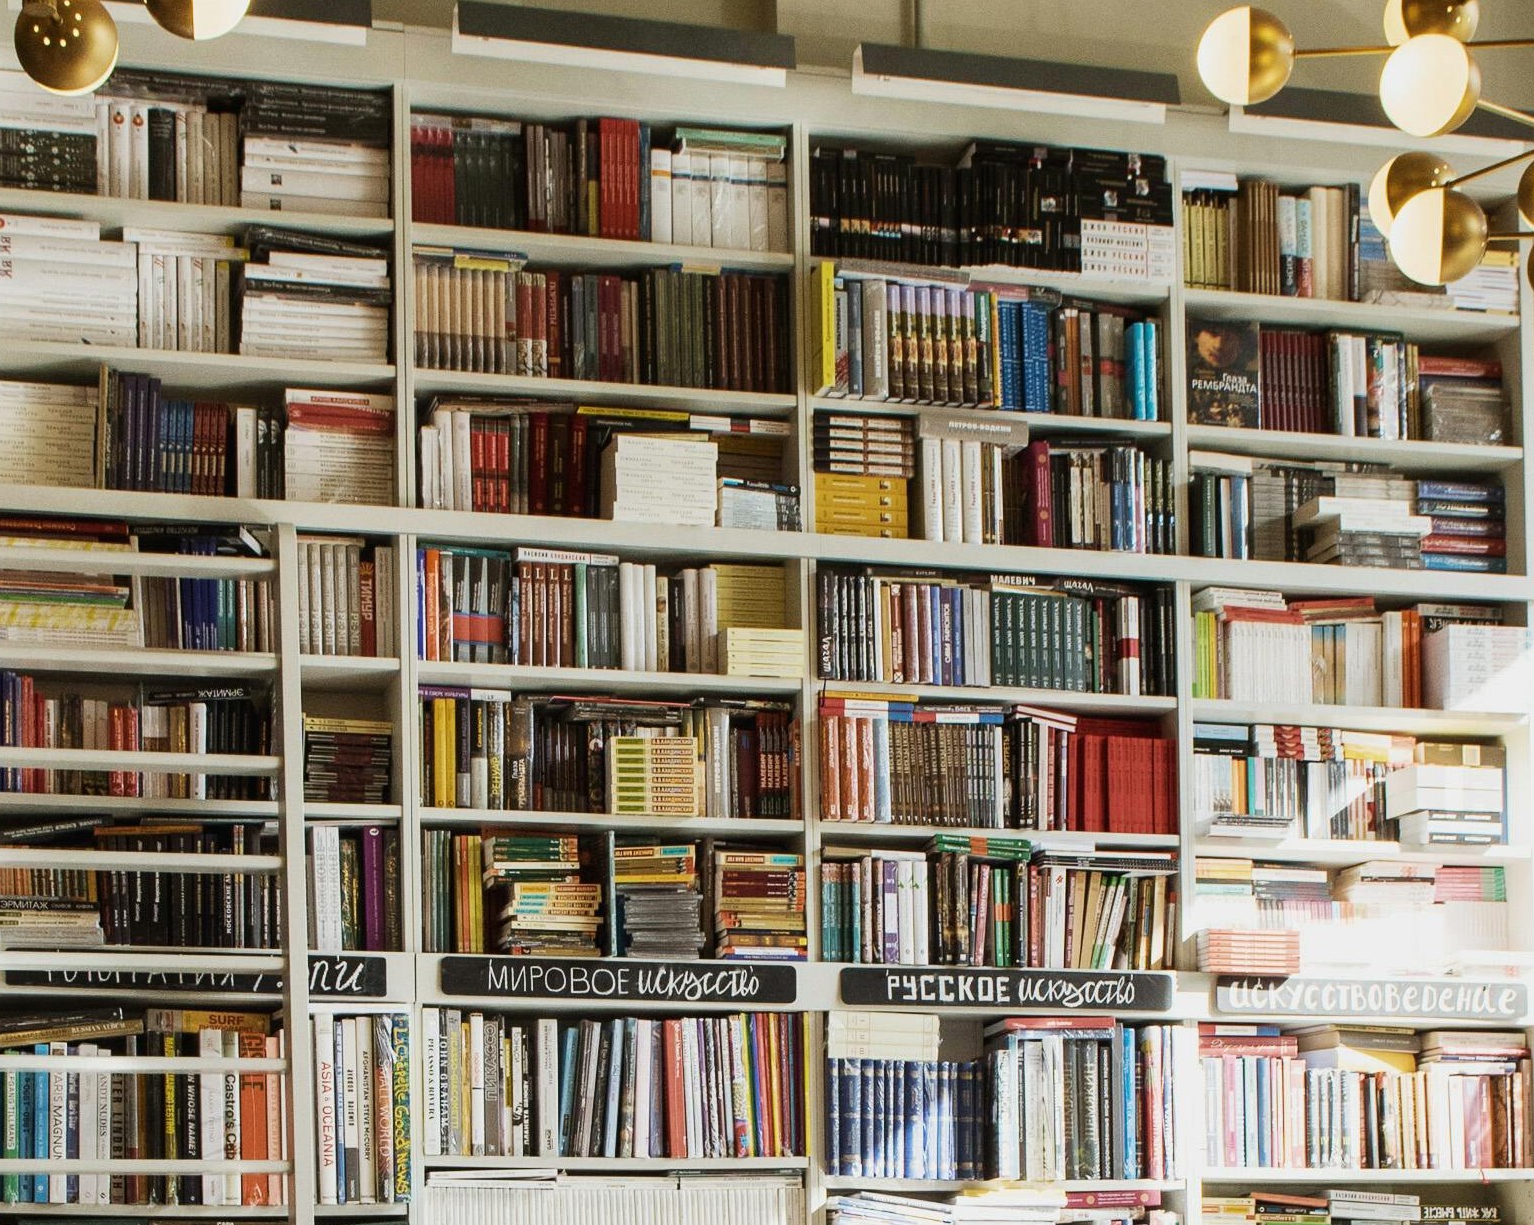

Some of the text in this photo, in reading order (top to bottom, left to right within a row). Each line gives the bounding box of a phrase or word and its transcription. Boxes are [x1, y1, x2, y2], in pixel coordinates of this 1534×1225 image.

[1191, 379, 1258, 394] РЕМБРАНДТА
[990, 574, 1035, 587] МАЛЕВИЧ
[362, 576, 372, 621] ТИМУР
[0, 900, 49, 910] ЭРМИТАЖ
[487, 963, 760, 999] МИРОВОЕ искусство
[887, 972, 1136, 1007] РУССКОЕ искусство
[208, 1014, 246, 1026] SURF
[440, 1034, 449, 1068] JOHN
[484, 1024, 498, 1102] ПИКАССО
[362, 1050, 370, 1101] AFGHANISTAN
[224, 1074, 237, 1129] Castro's
[321, 1061, 333, 1167] ASIA OCEANIA
[363, 1104, 371, 1126] STEVE
[100, 1103, 108, 1137] NUDES
[187, 1085, 197, 1157] WHOSE NAME?
[379, 1104, 391, 1157] WORLD
[394, 1104, 410, 1195] Good News
[1480, 1206, 1498, 1219] КАК
